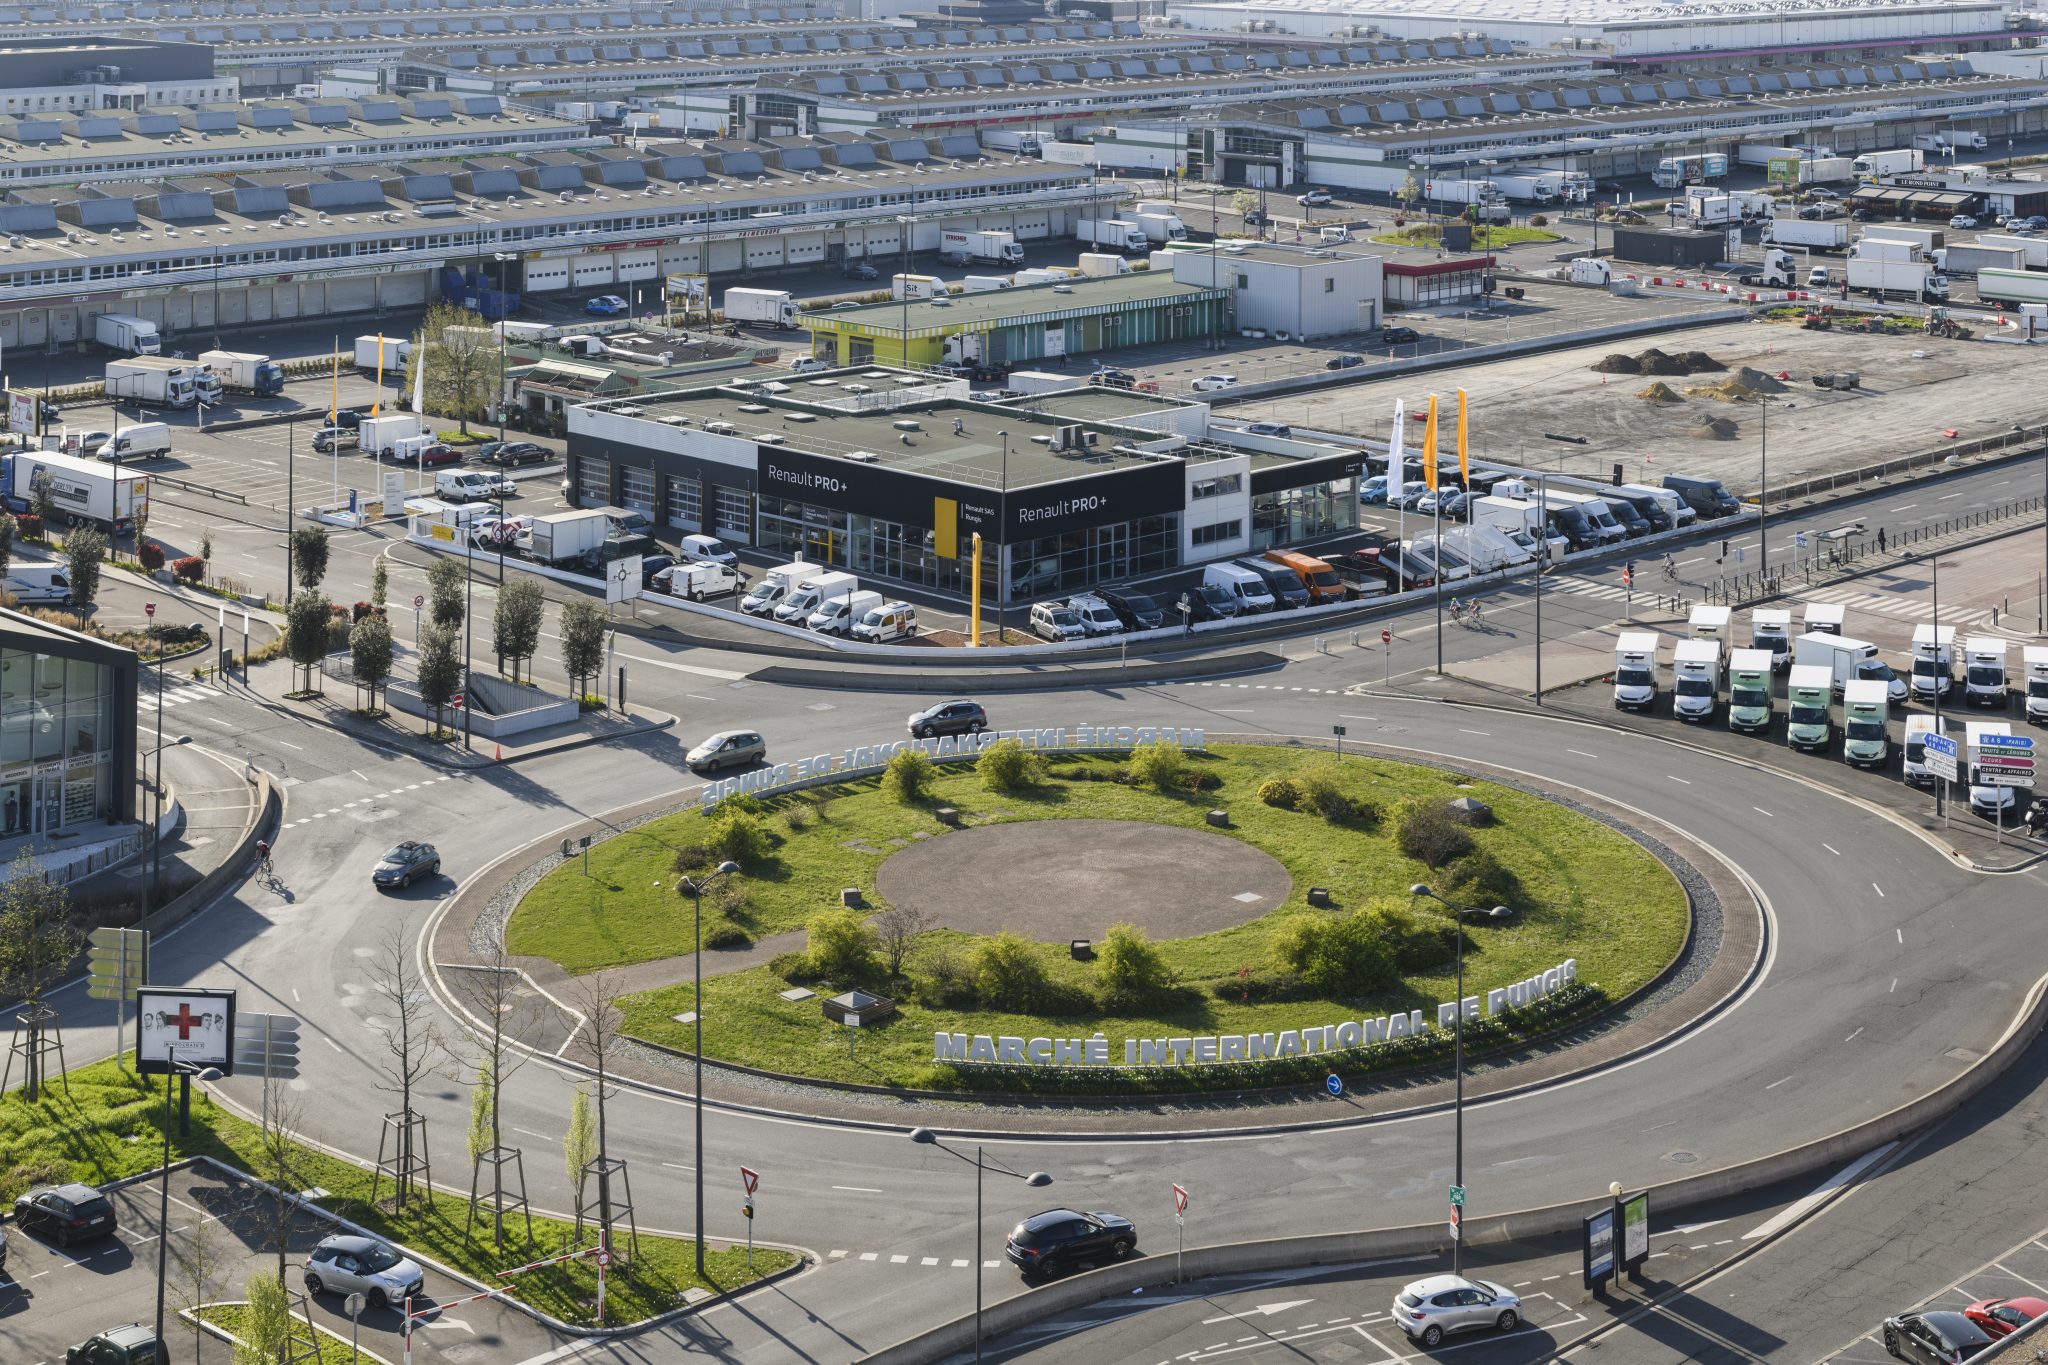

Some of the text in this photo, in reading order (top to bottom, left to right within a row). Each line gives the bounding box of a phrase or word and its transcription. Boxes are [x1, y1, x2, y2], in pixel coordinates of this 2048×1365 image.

[1619, 32, 1632, 47] C1
[696, 468, 702, 480] 2
[768, 464, 813, 487] Renault
[965, 503, 995, 516] Renault SAS
[965, 513, 982, 524] Rungis
[1019, 500, 1069, 524] Renault
[1438, 995, 1480, 1029] DE
[934, 1009, 1429, 1066] MARCHÉ INTERNATIONAL
